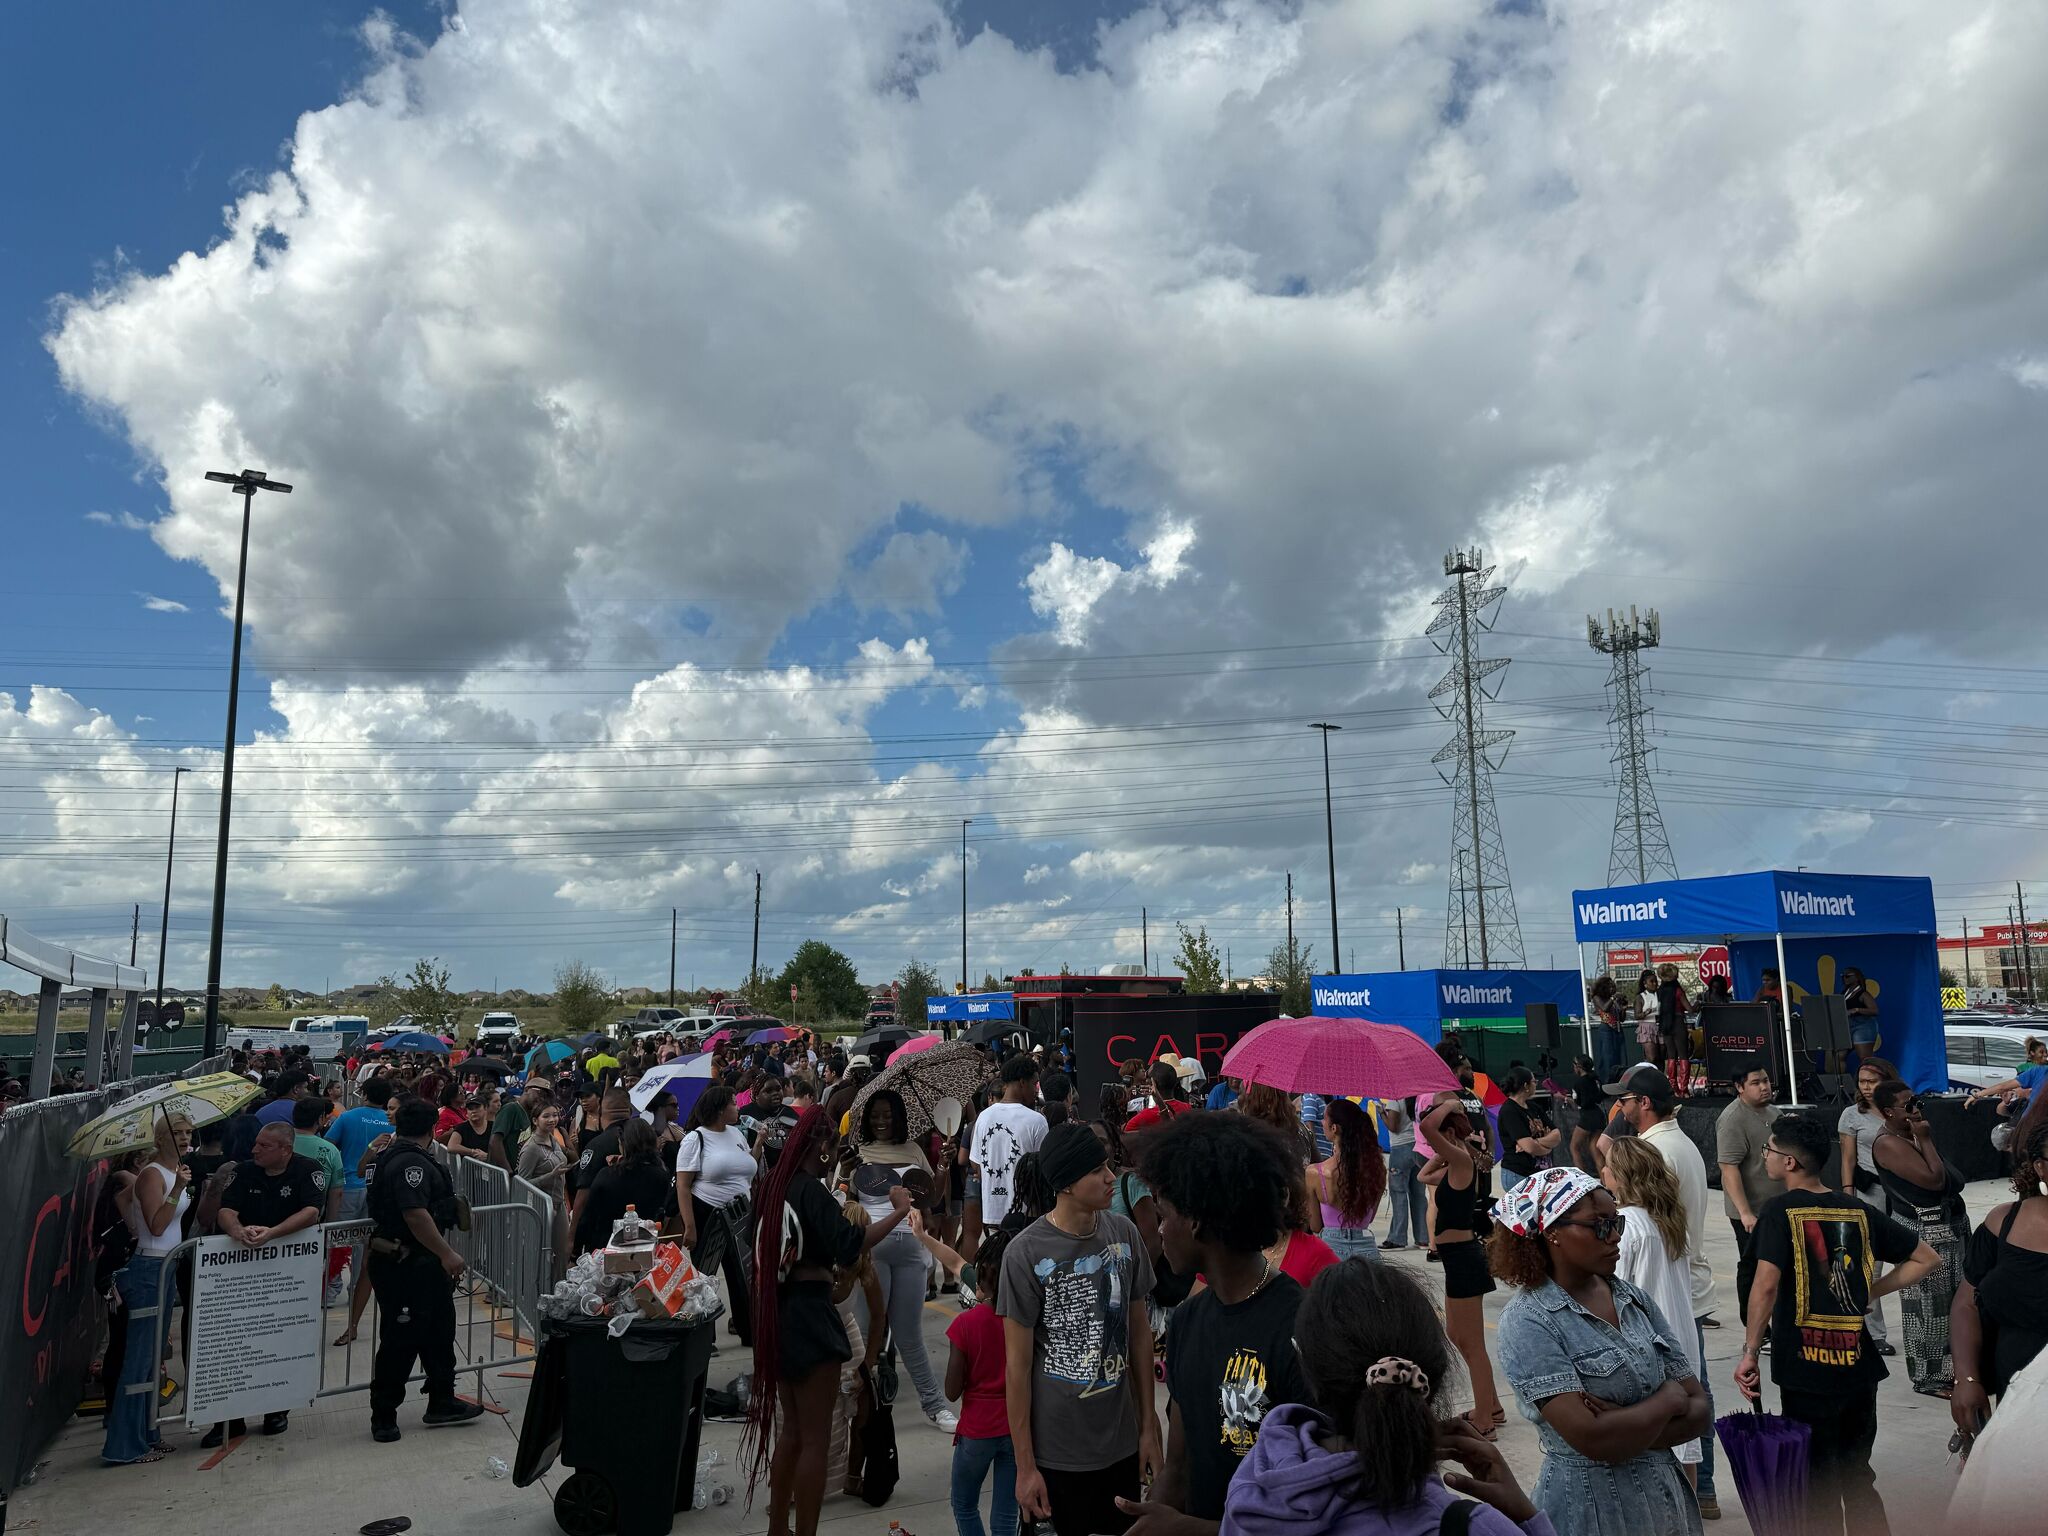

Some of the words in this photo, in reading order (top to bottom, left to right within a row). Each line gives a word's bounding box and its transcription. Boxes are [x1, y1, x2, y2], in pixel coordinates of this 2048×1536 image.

[1579, 897, 1668, 925] Walmart
[1780, 890, 1856, 917] Walmart
[1997, 932, 2018, 940] Publc
[1314, 988, 1371, 1007] Walmart
[1441, 984, 1513, 1005] Walmart
[927, 1004, 947, 1014] Walmart
[967, 1002, 990, 1013] Walmart
[1106, 1031, 1248, 1068] CAR
[1711, 1035, 1751, 1045] CARDI
[1756, 1036, 1765, 1045] B
[330, 1226, 375, 1240] NATIONA
[624, 1225, 632, 1234] G
[202, 1246, 278, 1267] PROHIBITED
[282, 1241, 319, 1258] ITEMS
[1802, 1346, 1860, 1367] WOLVE
[1223, 1353, 1267, 1389] FAITH
